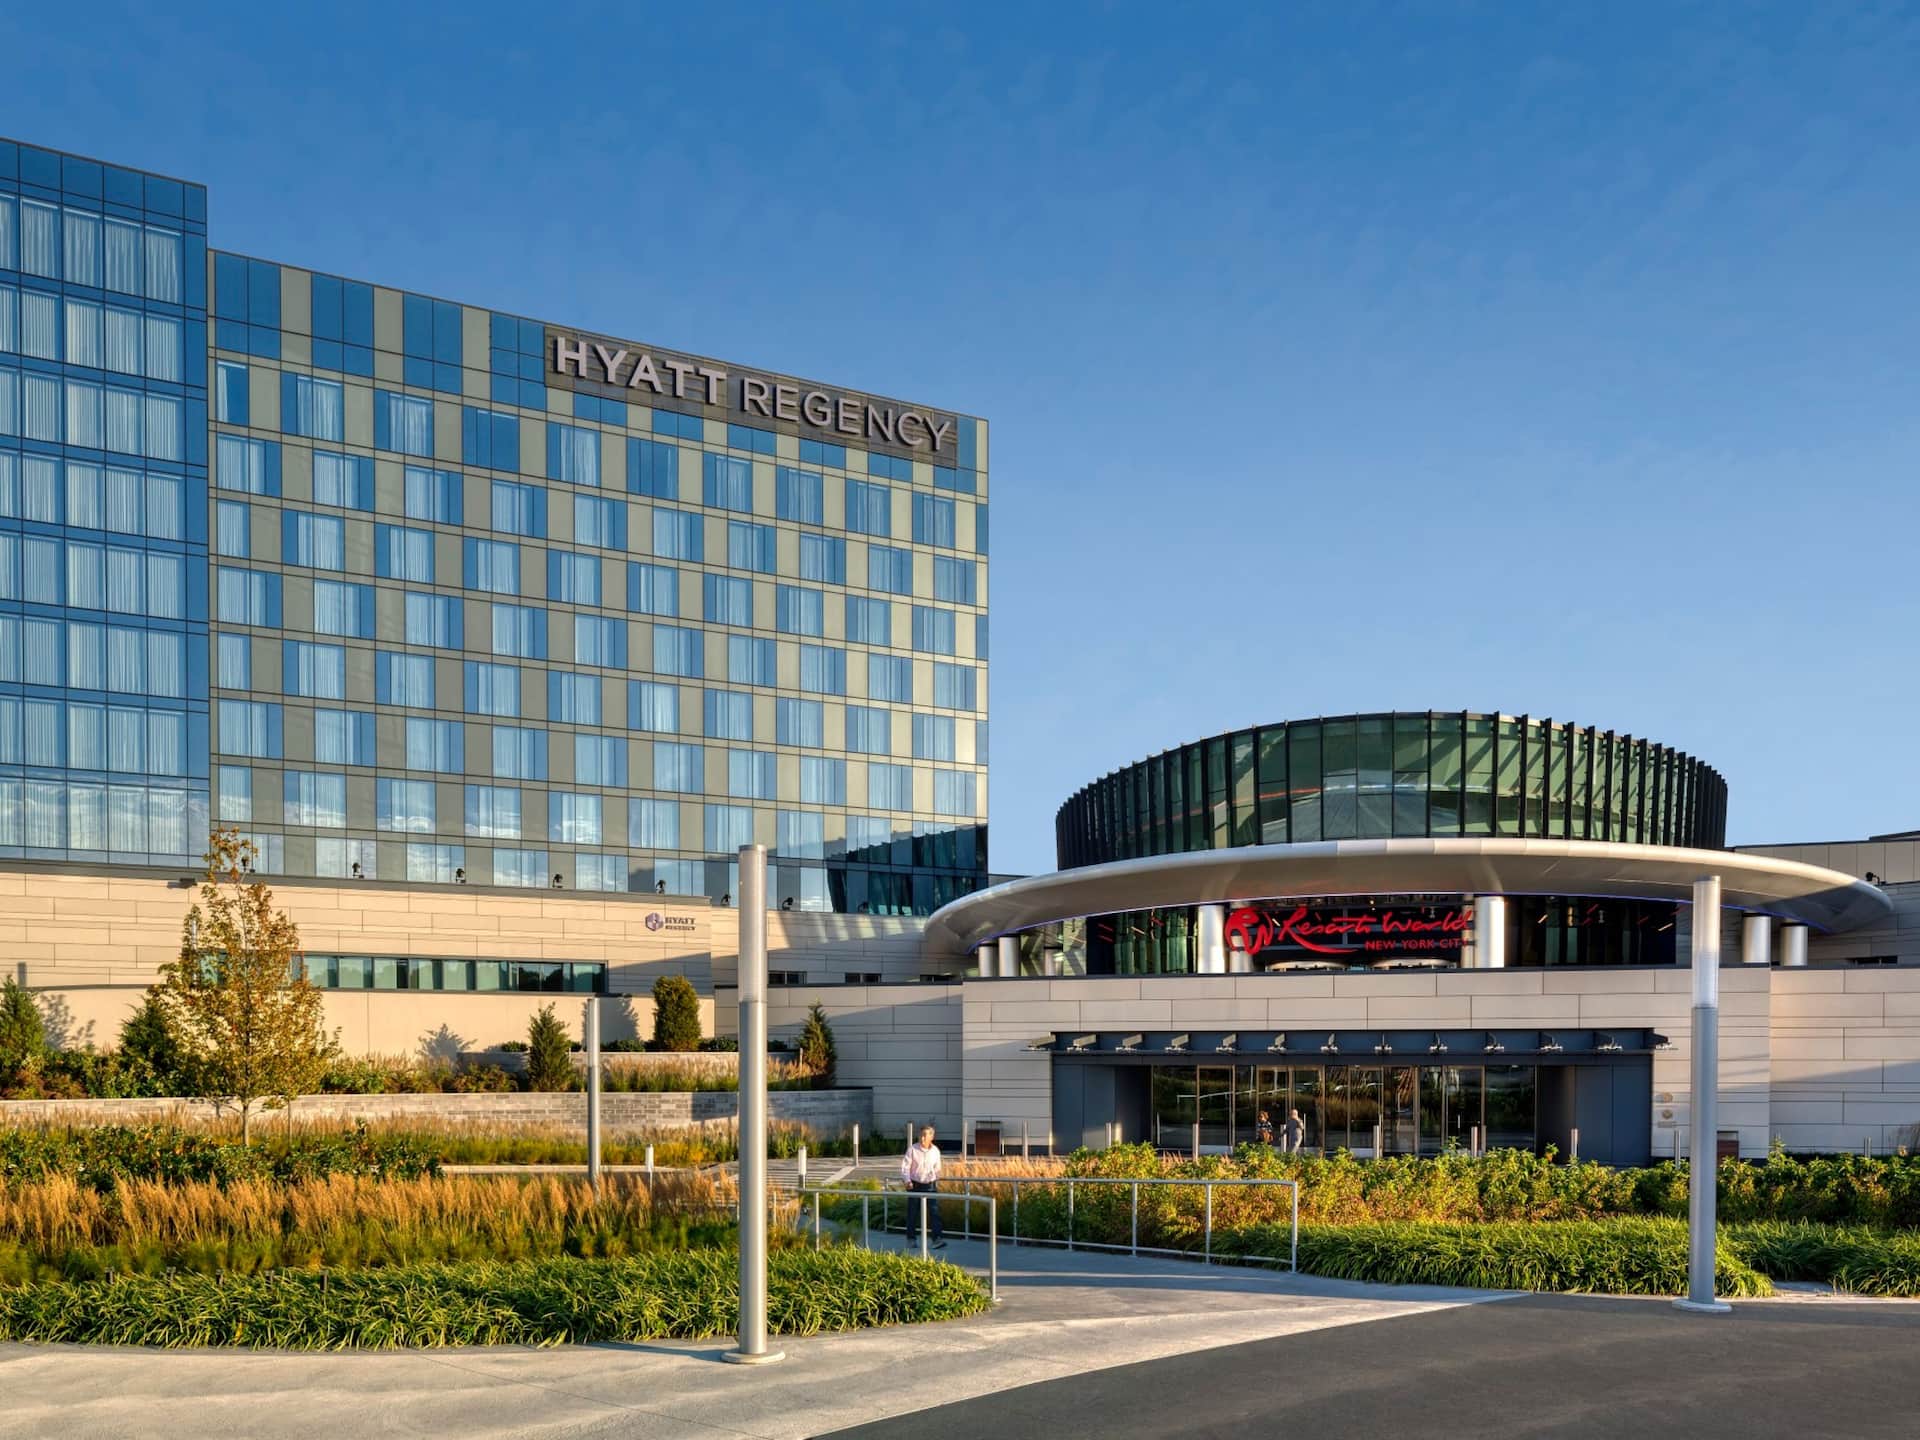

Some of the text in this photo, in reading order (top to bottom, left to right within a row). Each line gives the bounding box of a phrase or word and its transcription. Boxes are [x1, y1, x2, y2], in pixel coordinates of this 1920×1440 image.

[555, 336, 951, 452] HYATT REGENCY
[1278, 904, 1473, 953] Resorts World
[1365, 940, 1397, 951] NEW
[1401, 939, 1435, 950] YORK
